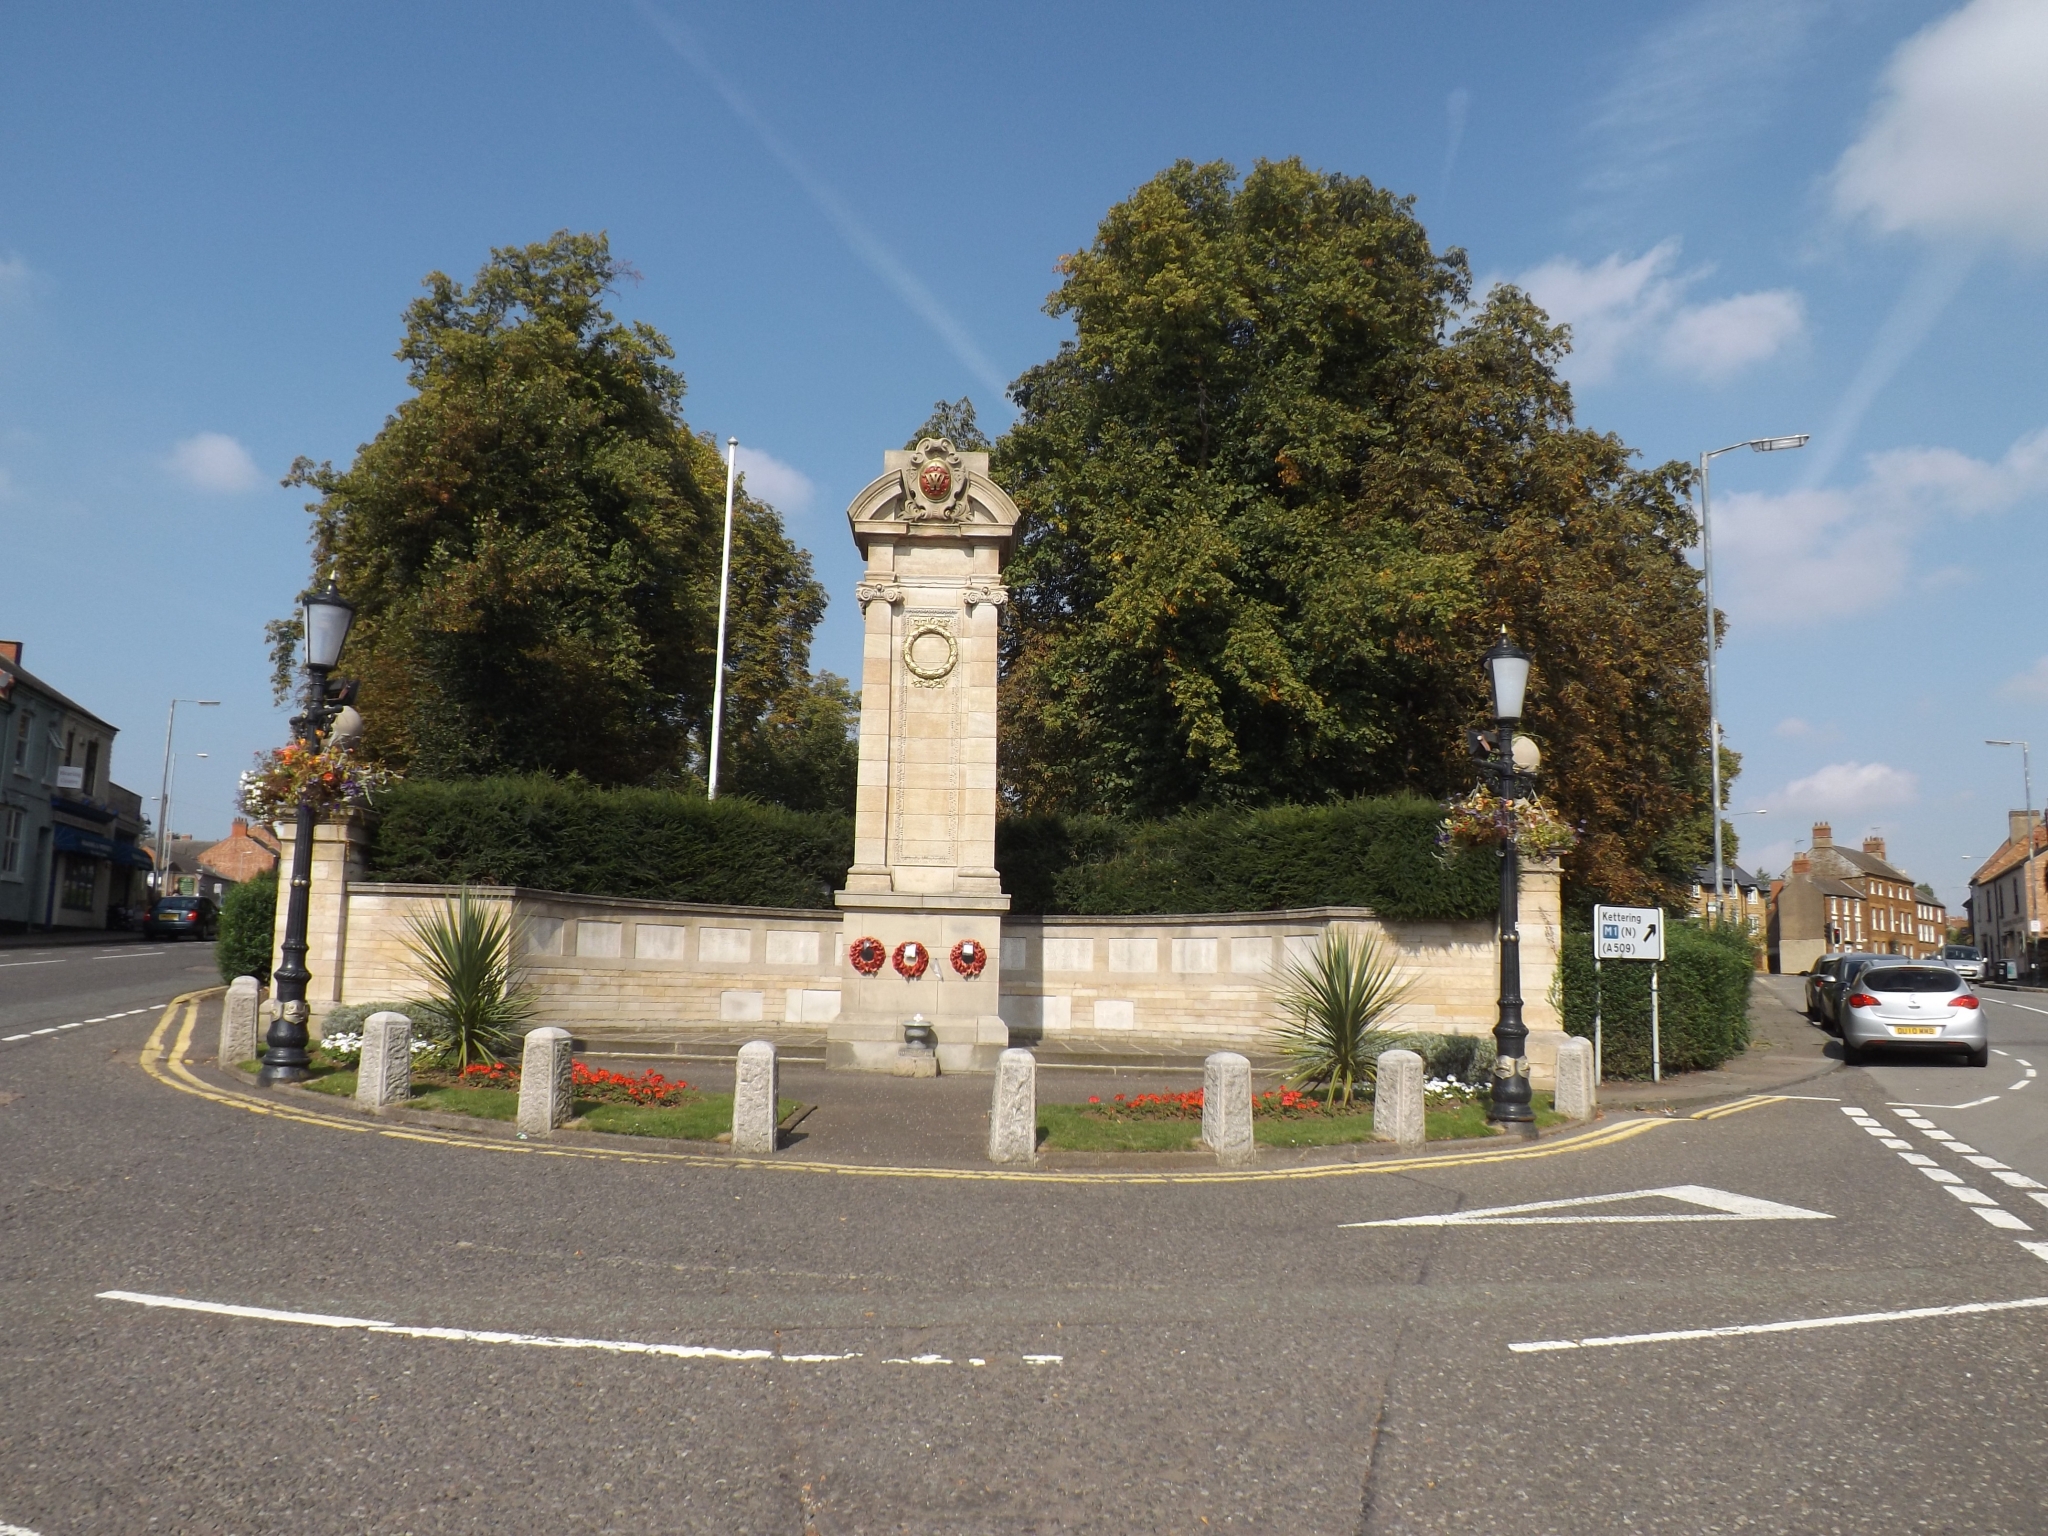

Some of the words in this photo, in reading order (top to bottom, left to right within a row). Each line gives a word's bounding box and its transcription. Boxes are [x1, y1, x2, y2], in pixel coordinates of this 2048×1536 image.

[1602, 911, 1642, 924] Kettering
[1604, 925, 1618, 936] M1
[1621, 926, 1636, 938] (N)
[1602, 943, 1635, 954] (A509)
